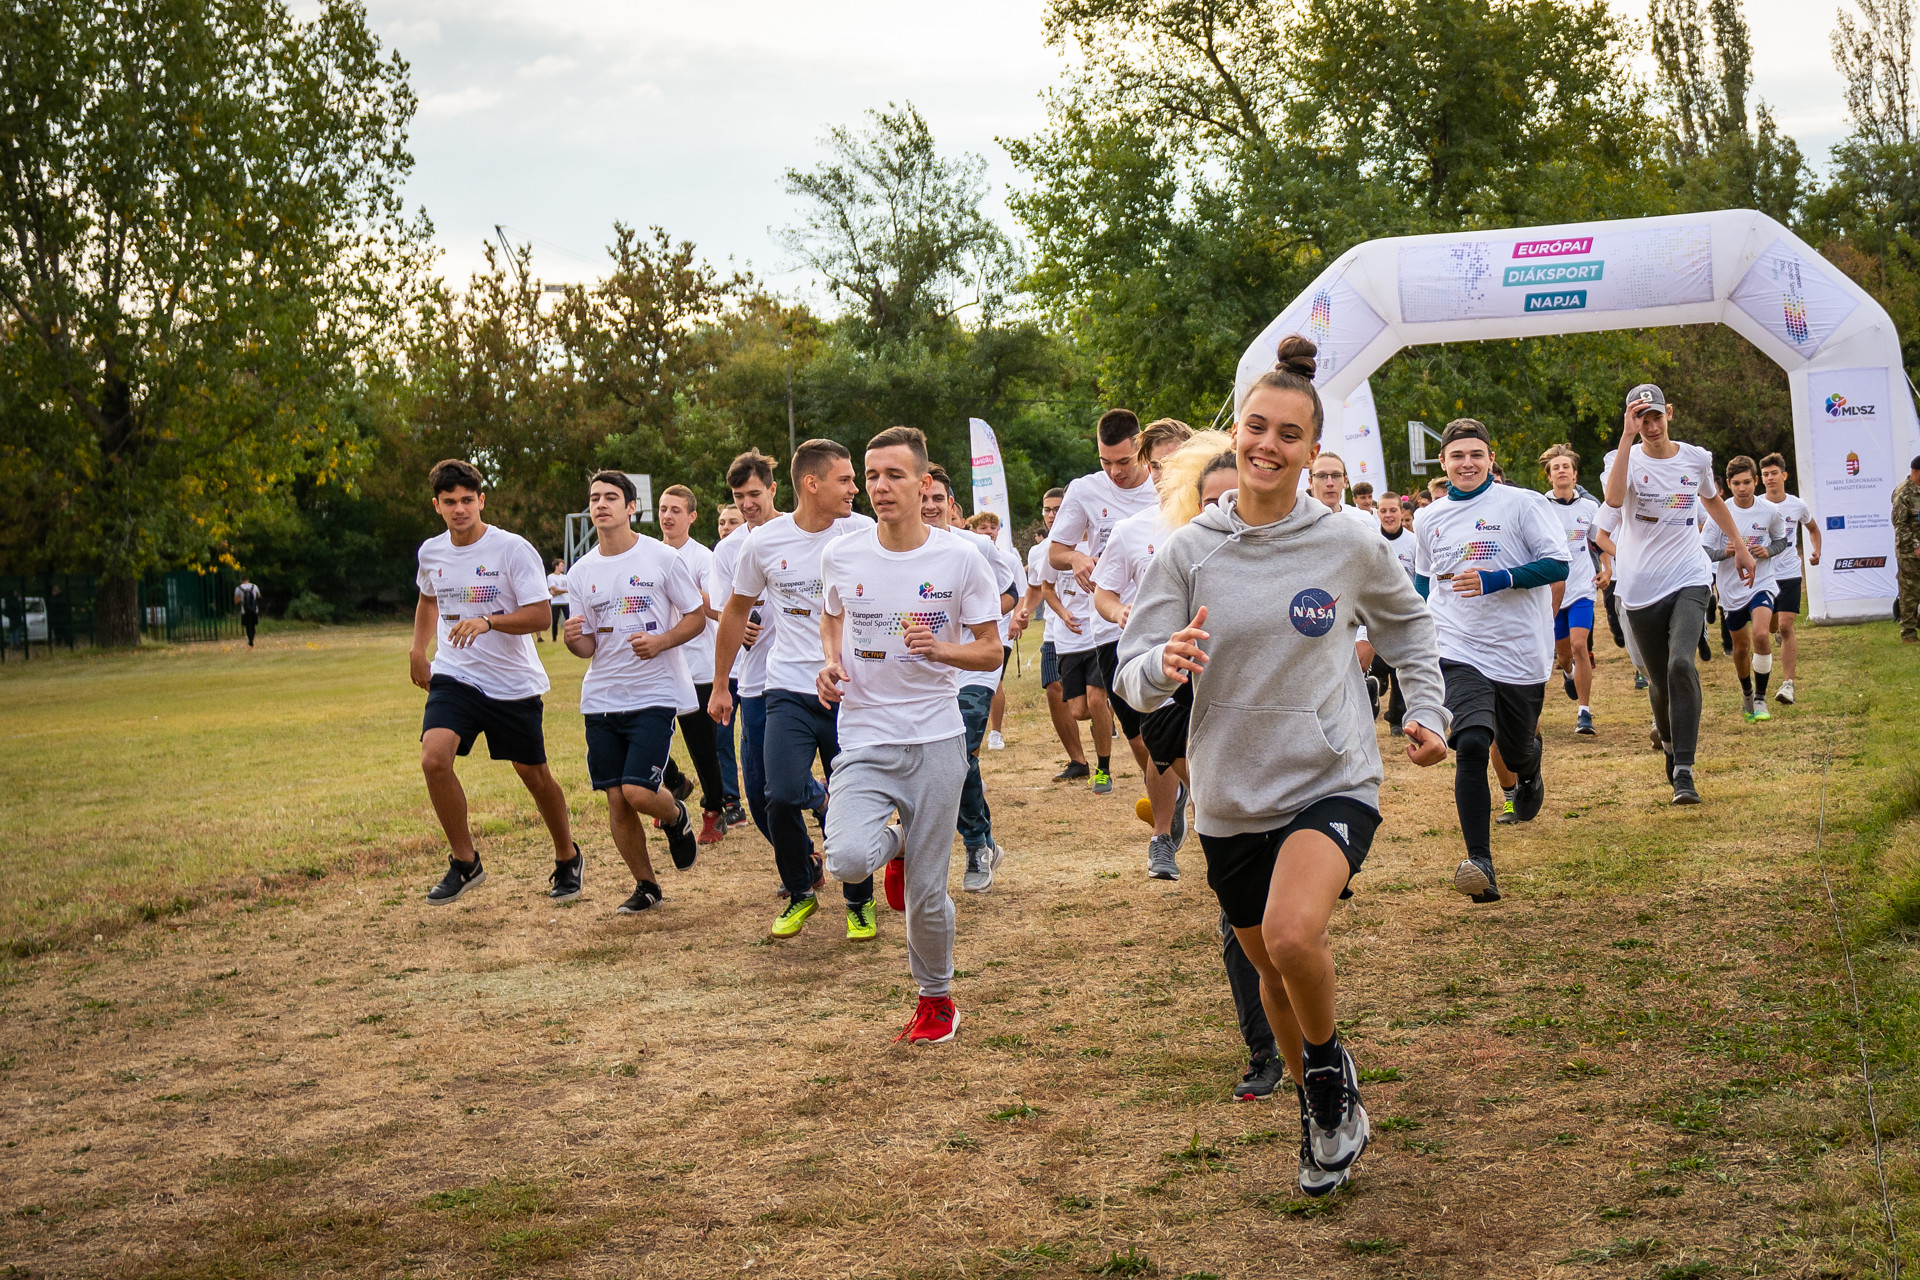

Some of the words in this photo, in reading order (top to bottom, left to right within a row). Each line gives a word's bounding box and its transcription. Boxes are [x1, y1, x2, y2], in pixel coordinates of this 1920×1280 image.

[1517, 240, 1588, 256] EURÓPAI
[1507, 265, 1599, 283] DIÁKSPORT
[1529, 294, 1581, 309] NAPJA
[1835, 557, 1885, 569] #BEACTIVE
[930, 591, 953, 599] MDSZ
[852, 611, 883, 621] European
[1293, 605, 1334, 620] NASA
[852, 619, 873, 627] School
[875, 620, 893, 628] Sport
